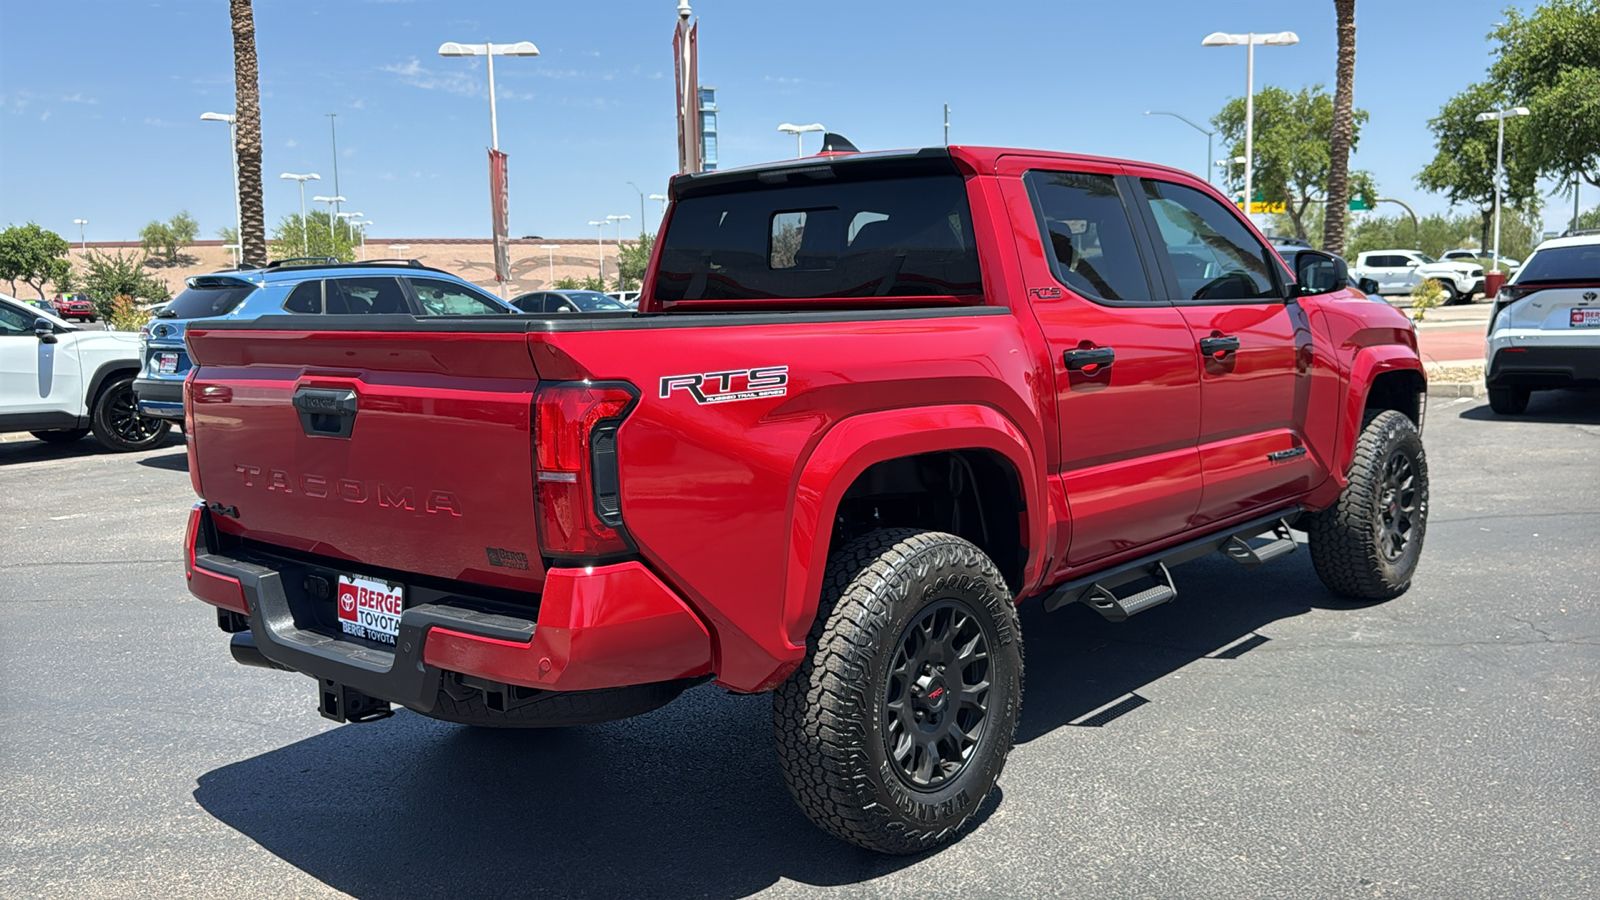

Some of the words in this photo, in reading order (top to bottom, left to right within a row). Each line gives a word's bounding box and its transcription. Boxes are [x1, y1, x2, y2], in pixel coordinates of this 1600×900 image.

[659, 366, 788, 405] RTS
[306, 397, 336, 410] TOYOTA
[234, 463, 463, 516] TACOMA
[359, 587, 402, 615] BERGE
[921, 574, 1012, 646] GOODYEAR
[343, 621, 366, 638] BERGE
[367, 629, 396, 645] TOYOTA
[359, 611, 401, 632] TOYOTA
[879, 760, 971, 822] WRANGLER
